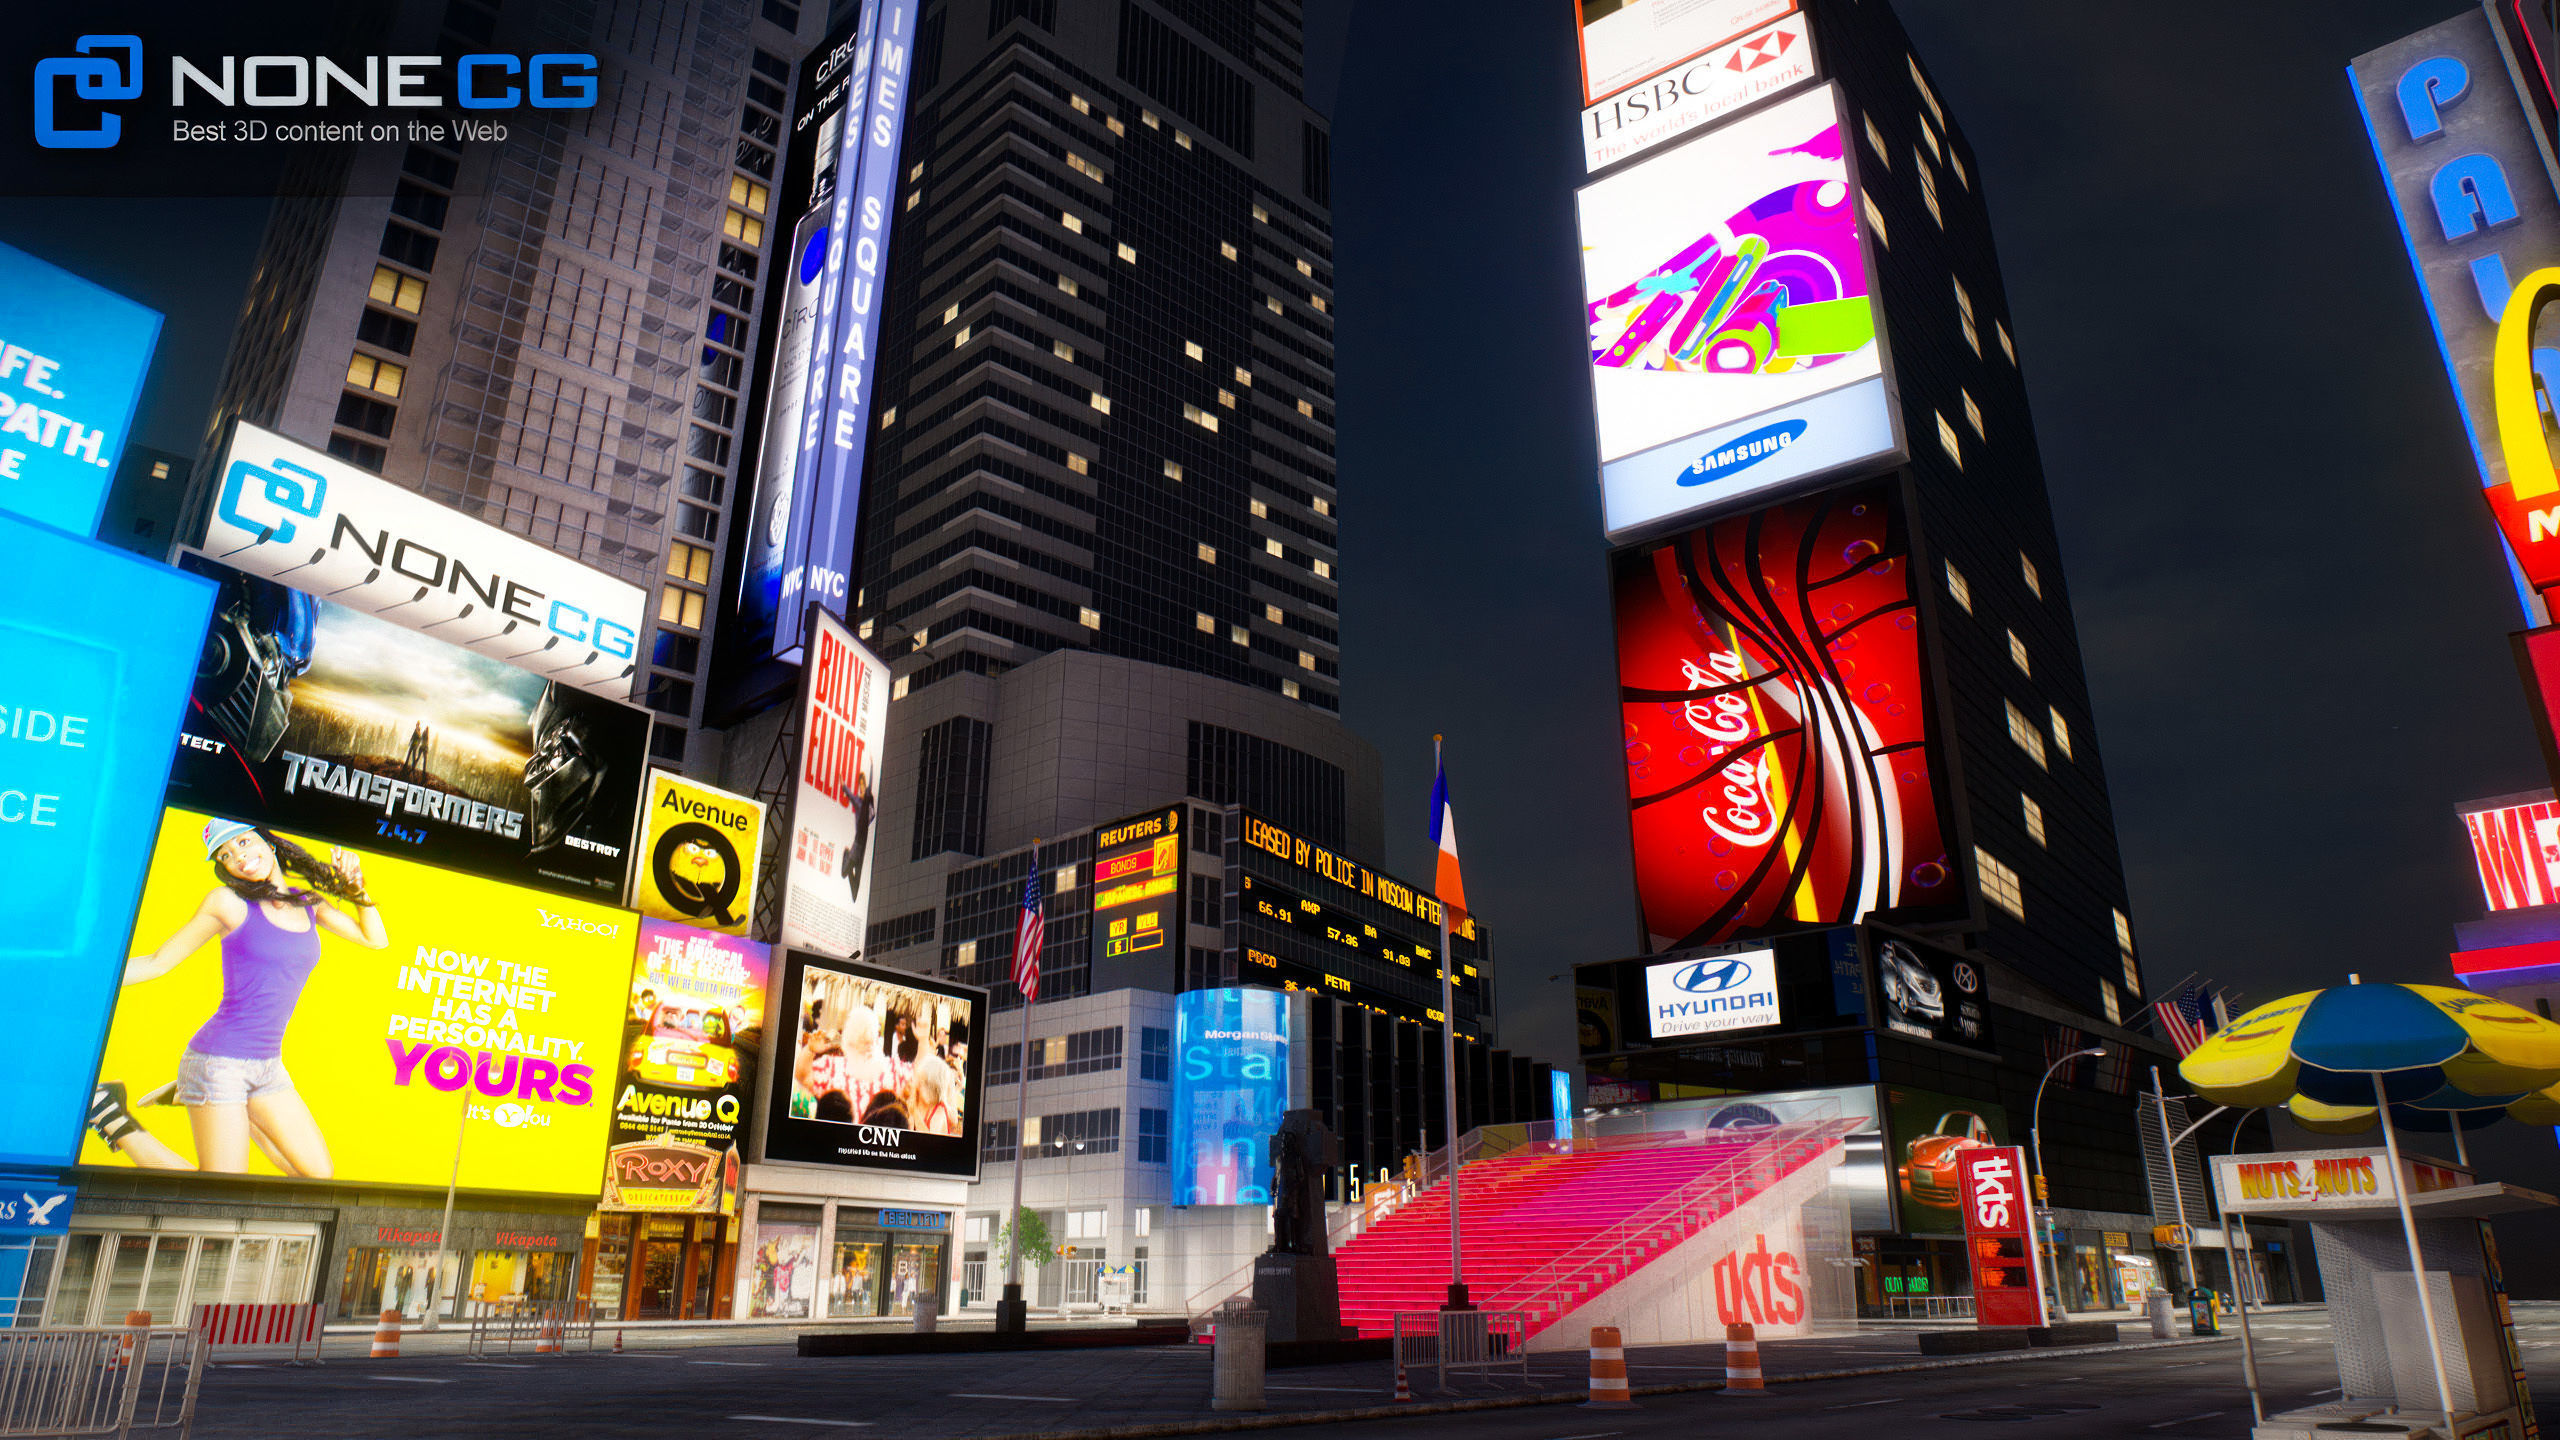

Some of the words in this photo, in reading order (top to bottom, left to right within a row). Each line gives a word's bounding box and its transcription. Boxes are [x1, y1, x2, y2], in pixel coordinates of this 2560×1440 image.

[797, 108, 814, 131] ON
[816, 87, 838, 112] THE
[1592, 62, 1712, 140] HSBC
[1594, 140, 1626, 163] The
[1632, 107, 1698, 146] world's
[1703, 84, 1749, 117] local
[1754, 63, 1804, 95] bank
[804, 196, 848, 451] SQUARE
[834, 196, 881, 449] SQUARE
[1692, 432, 1792, 475] SAMSUNG
[782, 565, 804, 600] NYC
[810, 565, 845, 598] NYC
[815, 629, 865, 728] BILLY
[281, 750, 525, 841] TRANSFORMERS
[661, 788, 748, 832] Avenue
[376, 819, 428, 845] 7.4.7
[565, 834, 621, 859] DESTROY
[1100, 817, 1162, 848] REUTERS
[653, 822, 746, 926] Q
[1245, 816, 1290, 860] LEASED
[1295, 838, 1311, 869] BY
[1315, 848, 1356, 889] POLICE
[1361, 868, 1374, 898] IN
[1378, 876, 1414, 915] MOSCOW
[537, 908, 619, 939] YAHOO!
[1259, 900, 1292, 923] 66.91
[415, 945, 490, 977] NOW
[497, 960, 548, 988] THE
[397, 966, 556, 1013] INTERNET
[1658, 991, 1773, 1019] HYUNDAI
[431, 997, 492, 1026] HAS
[497, 1009, 518, 1030] A
[1661, 1018, 1702, 1034] Drive
[1704, 1015, 1737, 1033] your
[1741, 1011, 1774, 1027] way
[387, 1014, 584, 1061] PERSONALITY.
[385, 1038, 595, 1107] YOURS.
[466, 1104, 491, 1121] It's
[616, 1084, 711, 1120] Avenue
[716, 1094, 740, 1124] Q
[858, 1126, 901, 1147] CNN
[616, 1152, 707, 1183] ROXY
[1972, 1155, 2014, 1229] tkts
